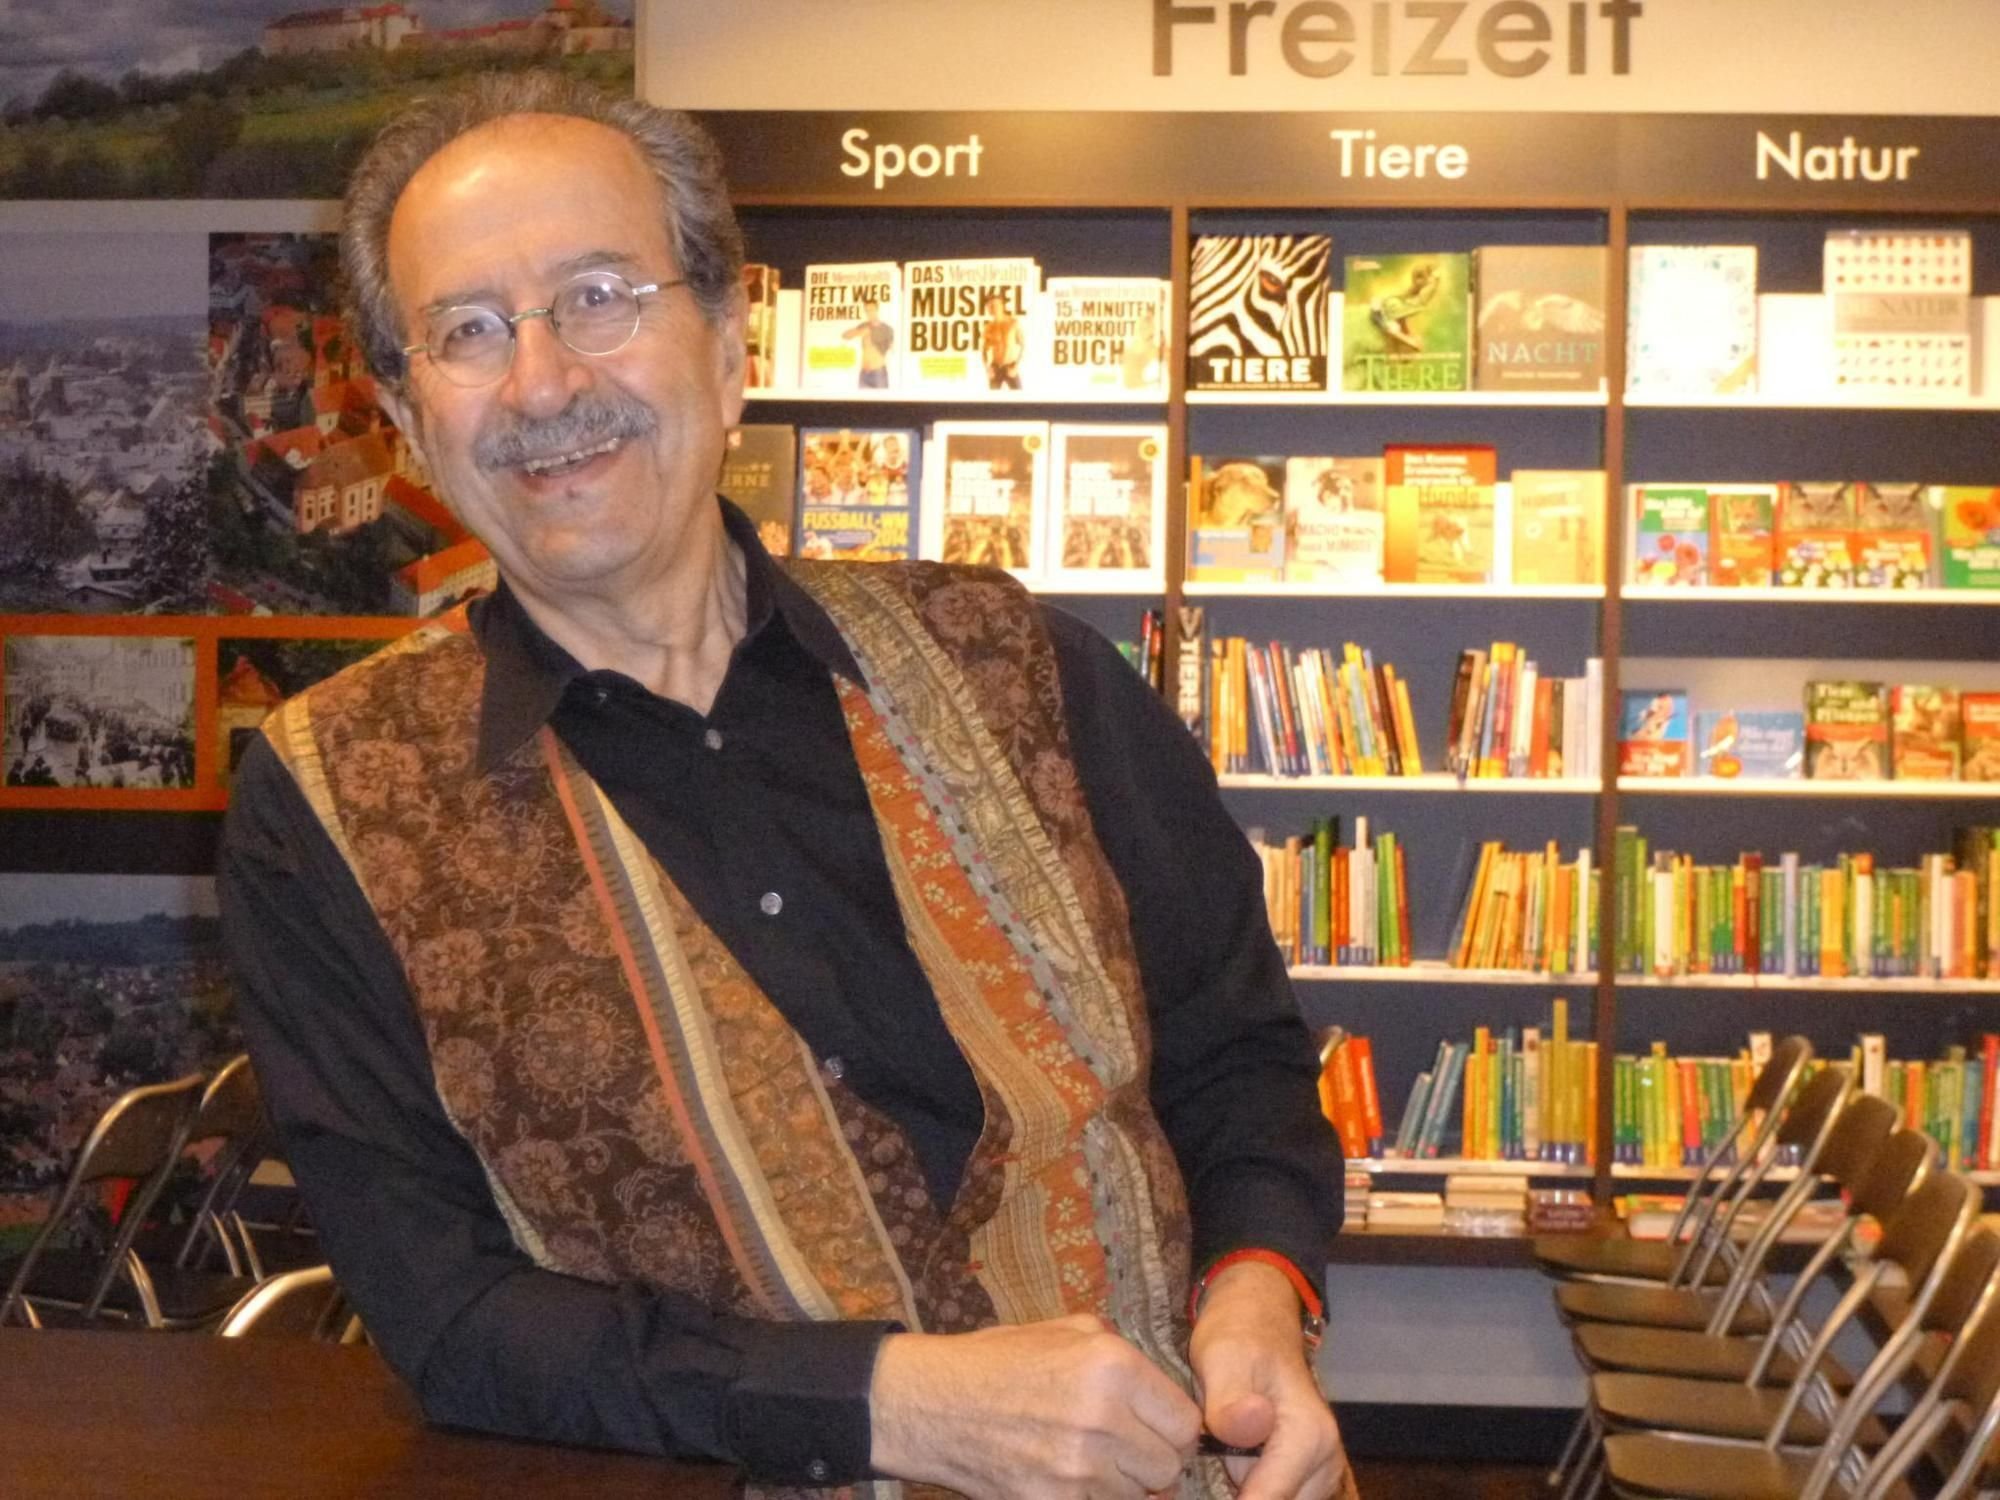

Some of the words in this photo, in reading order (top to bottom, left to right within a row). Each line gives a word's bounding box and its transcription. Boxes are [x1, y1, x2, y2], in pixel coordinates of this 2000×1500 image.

[1151, 0, 1643, 79] Freizeit
[840, 128, 984, 190] Sport
[1330, 129, 1470, 180] Tiere
[1756, 130, 1919, 181] Natur
[810, 271, 829, 285] DIE
[911, 265, 945, 284] DAS
[809, 285, 848, 305] FETT
[852, 284, 891, 304] WEG
[911, 285, 1027, 318] MUSKEL
[809, 305, 862, 321] FORMEL
[1054, 319, 1137, 337] WORKOUT
[1053, 338, 1125, 366] BUCH
[1487, 341, 1601, 364] NACHT
[1208, 357, 1312, 384] TIERE
